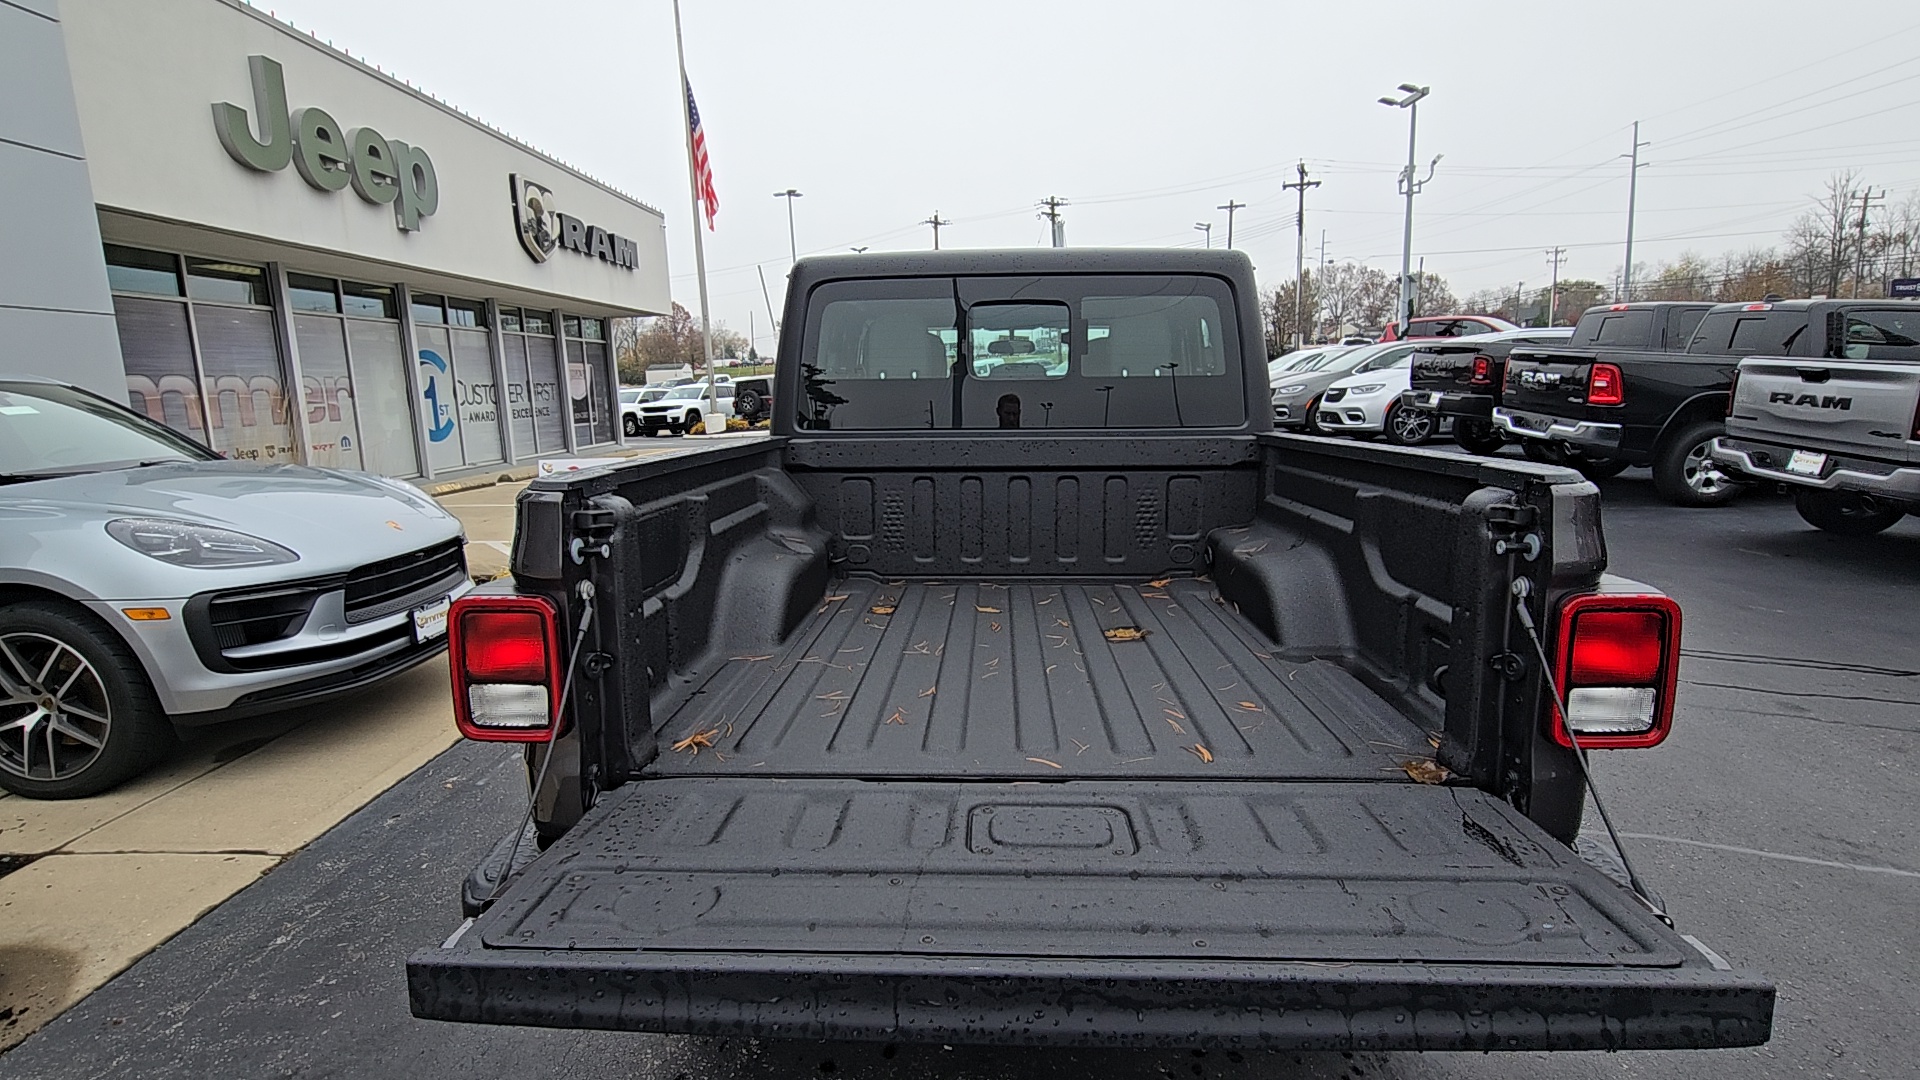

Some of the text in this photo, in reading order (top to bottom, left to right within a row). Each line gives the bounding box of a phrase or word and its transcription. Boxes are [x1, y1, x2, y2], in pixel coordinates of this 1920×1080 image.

[211, 55, 438, 232] Jeep
[558, 212, 639, 270] RAM
[1521, 370, 1561, 385] RAM
[453, 379, 556, 407] CUSTOER IRST
[1769, 392, 1853, 411] RAM
[468, 410, 496, 424] AWARD
[232, 447, 259, 461] Jeep
